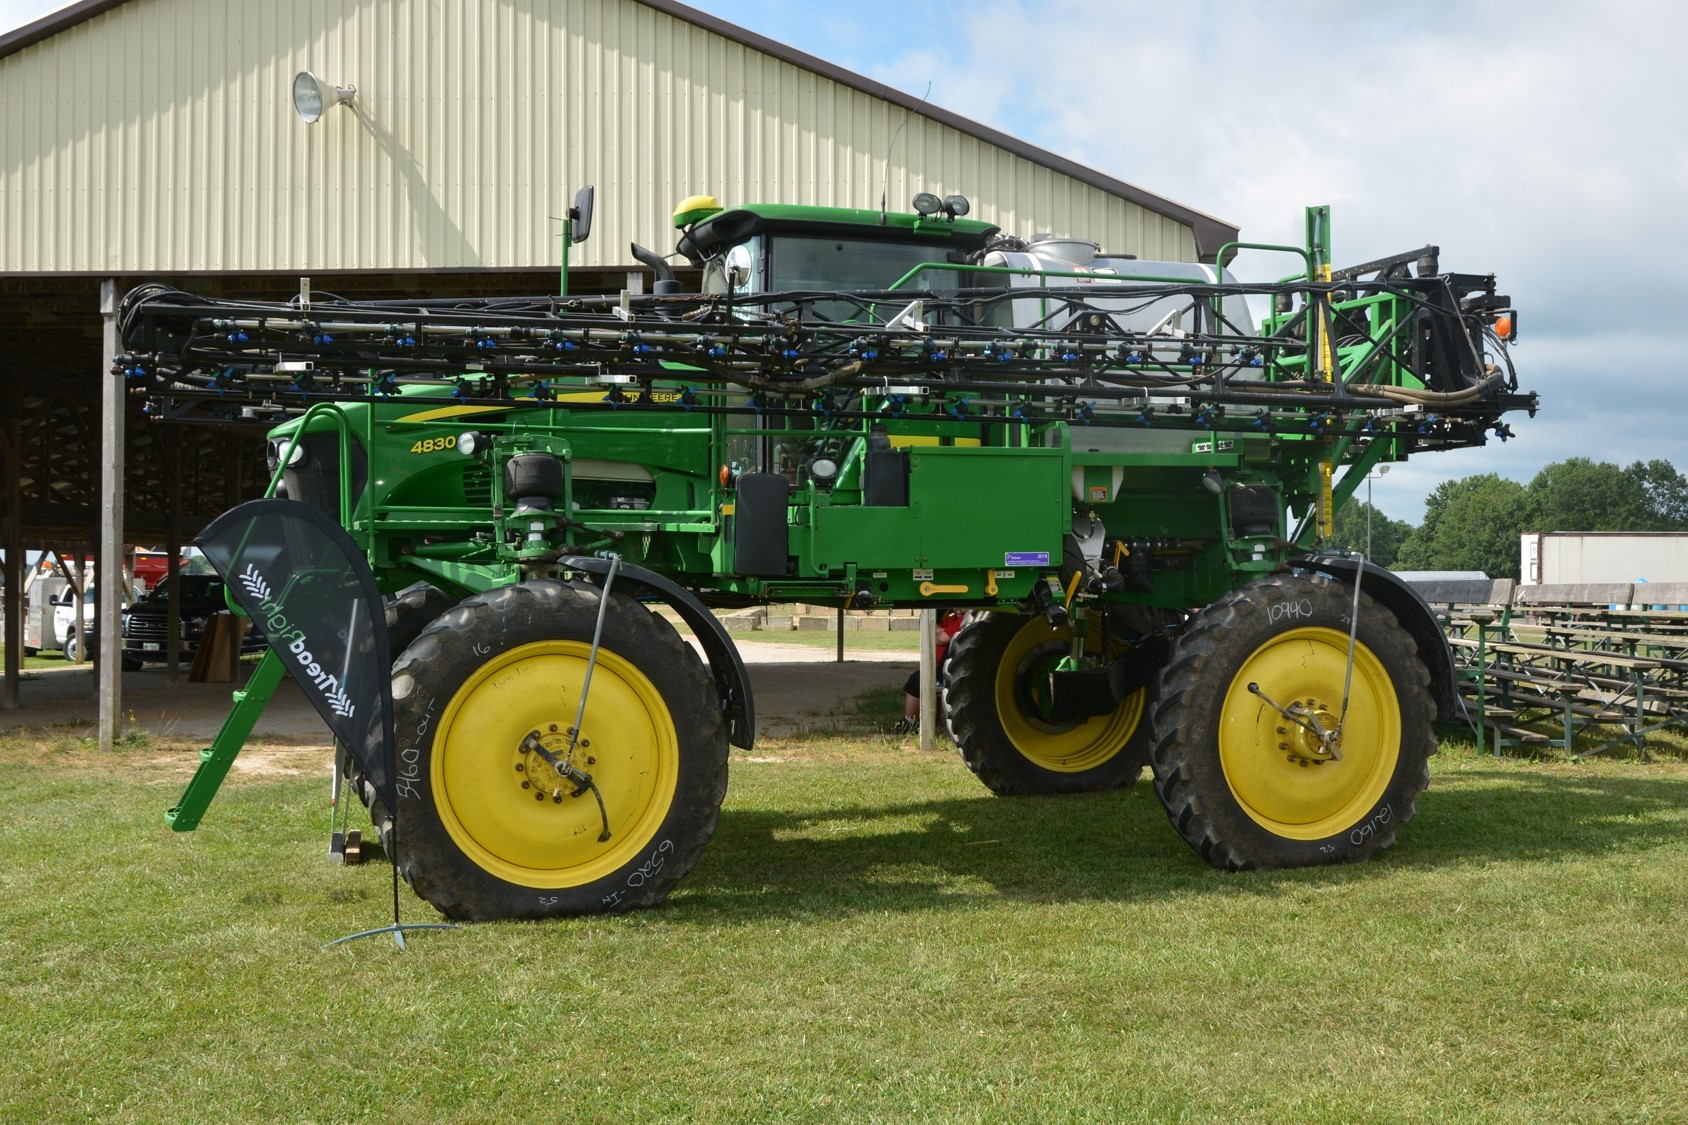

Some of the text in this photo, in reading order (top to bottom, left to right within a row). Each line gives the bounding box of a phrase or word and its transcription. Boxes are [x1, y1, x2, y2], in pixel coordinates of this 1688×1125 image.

[411, 436, 456, 453] 4830
[1266, 598, 1313, 625] 10940
[472, 642, 491, 656] 16
[1350, 802, 1394, 845] 12160
